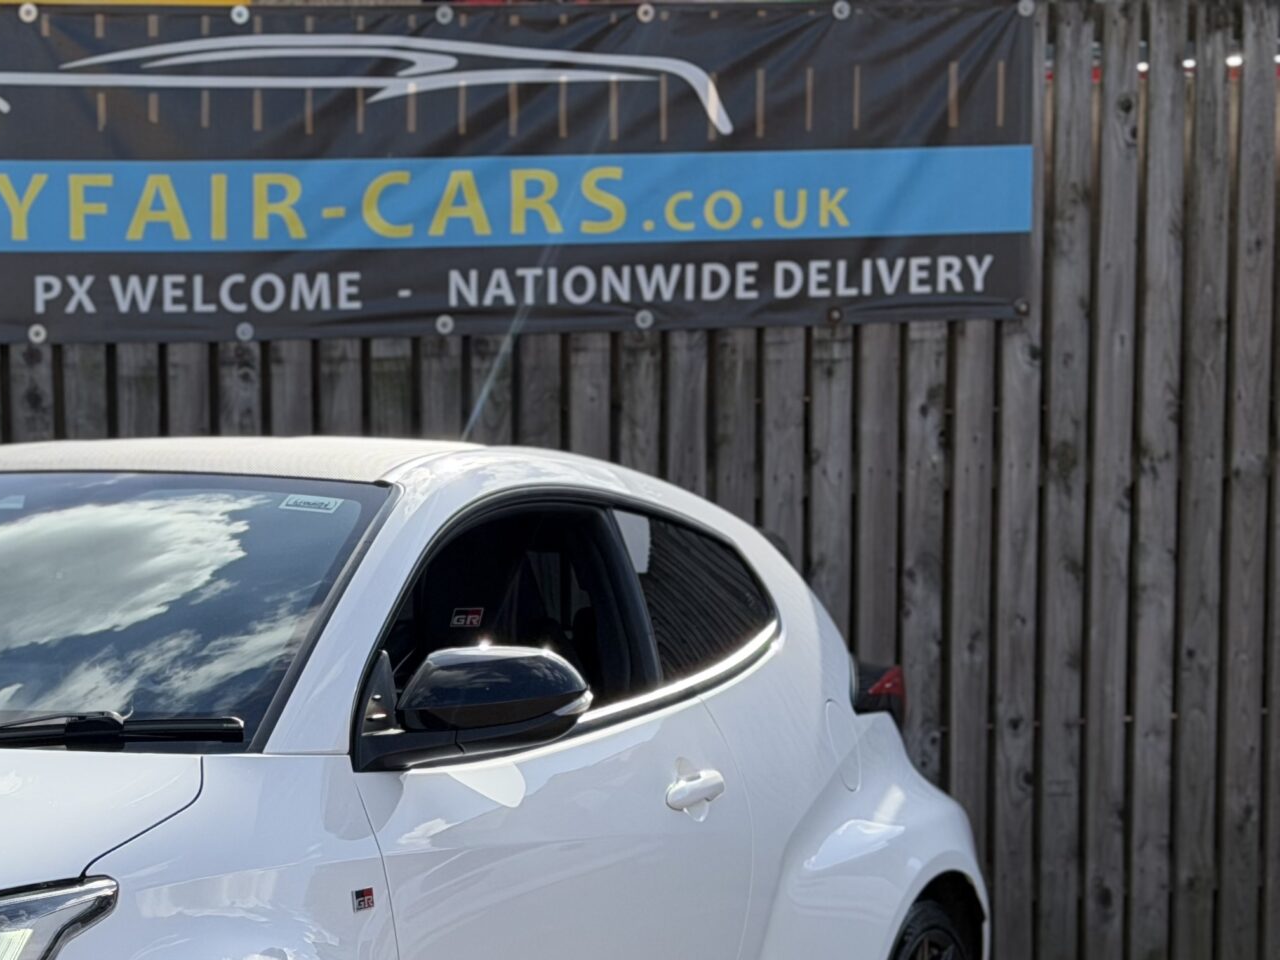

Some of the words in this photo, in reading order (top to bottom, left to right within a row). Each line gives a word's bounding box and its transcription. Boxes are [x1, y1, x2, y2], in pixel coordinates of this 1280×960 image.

[35, 275, 95, 313] PX
[109, 272, 361, 313] WELCOME
[449, 262, 758, 306] NATIONWIDE
[774, 255, 993, 298] DELIVERY
